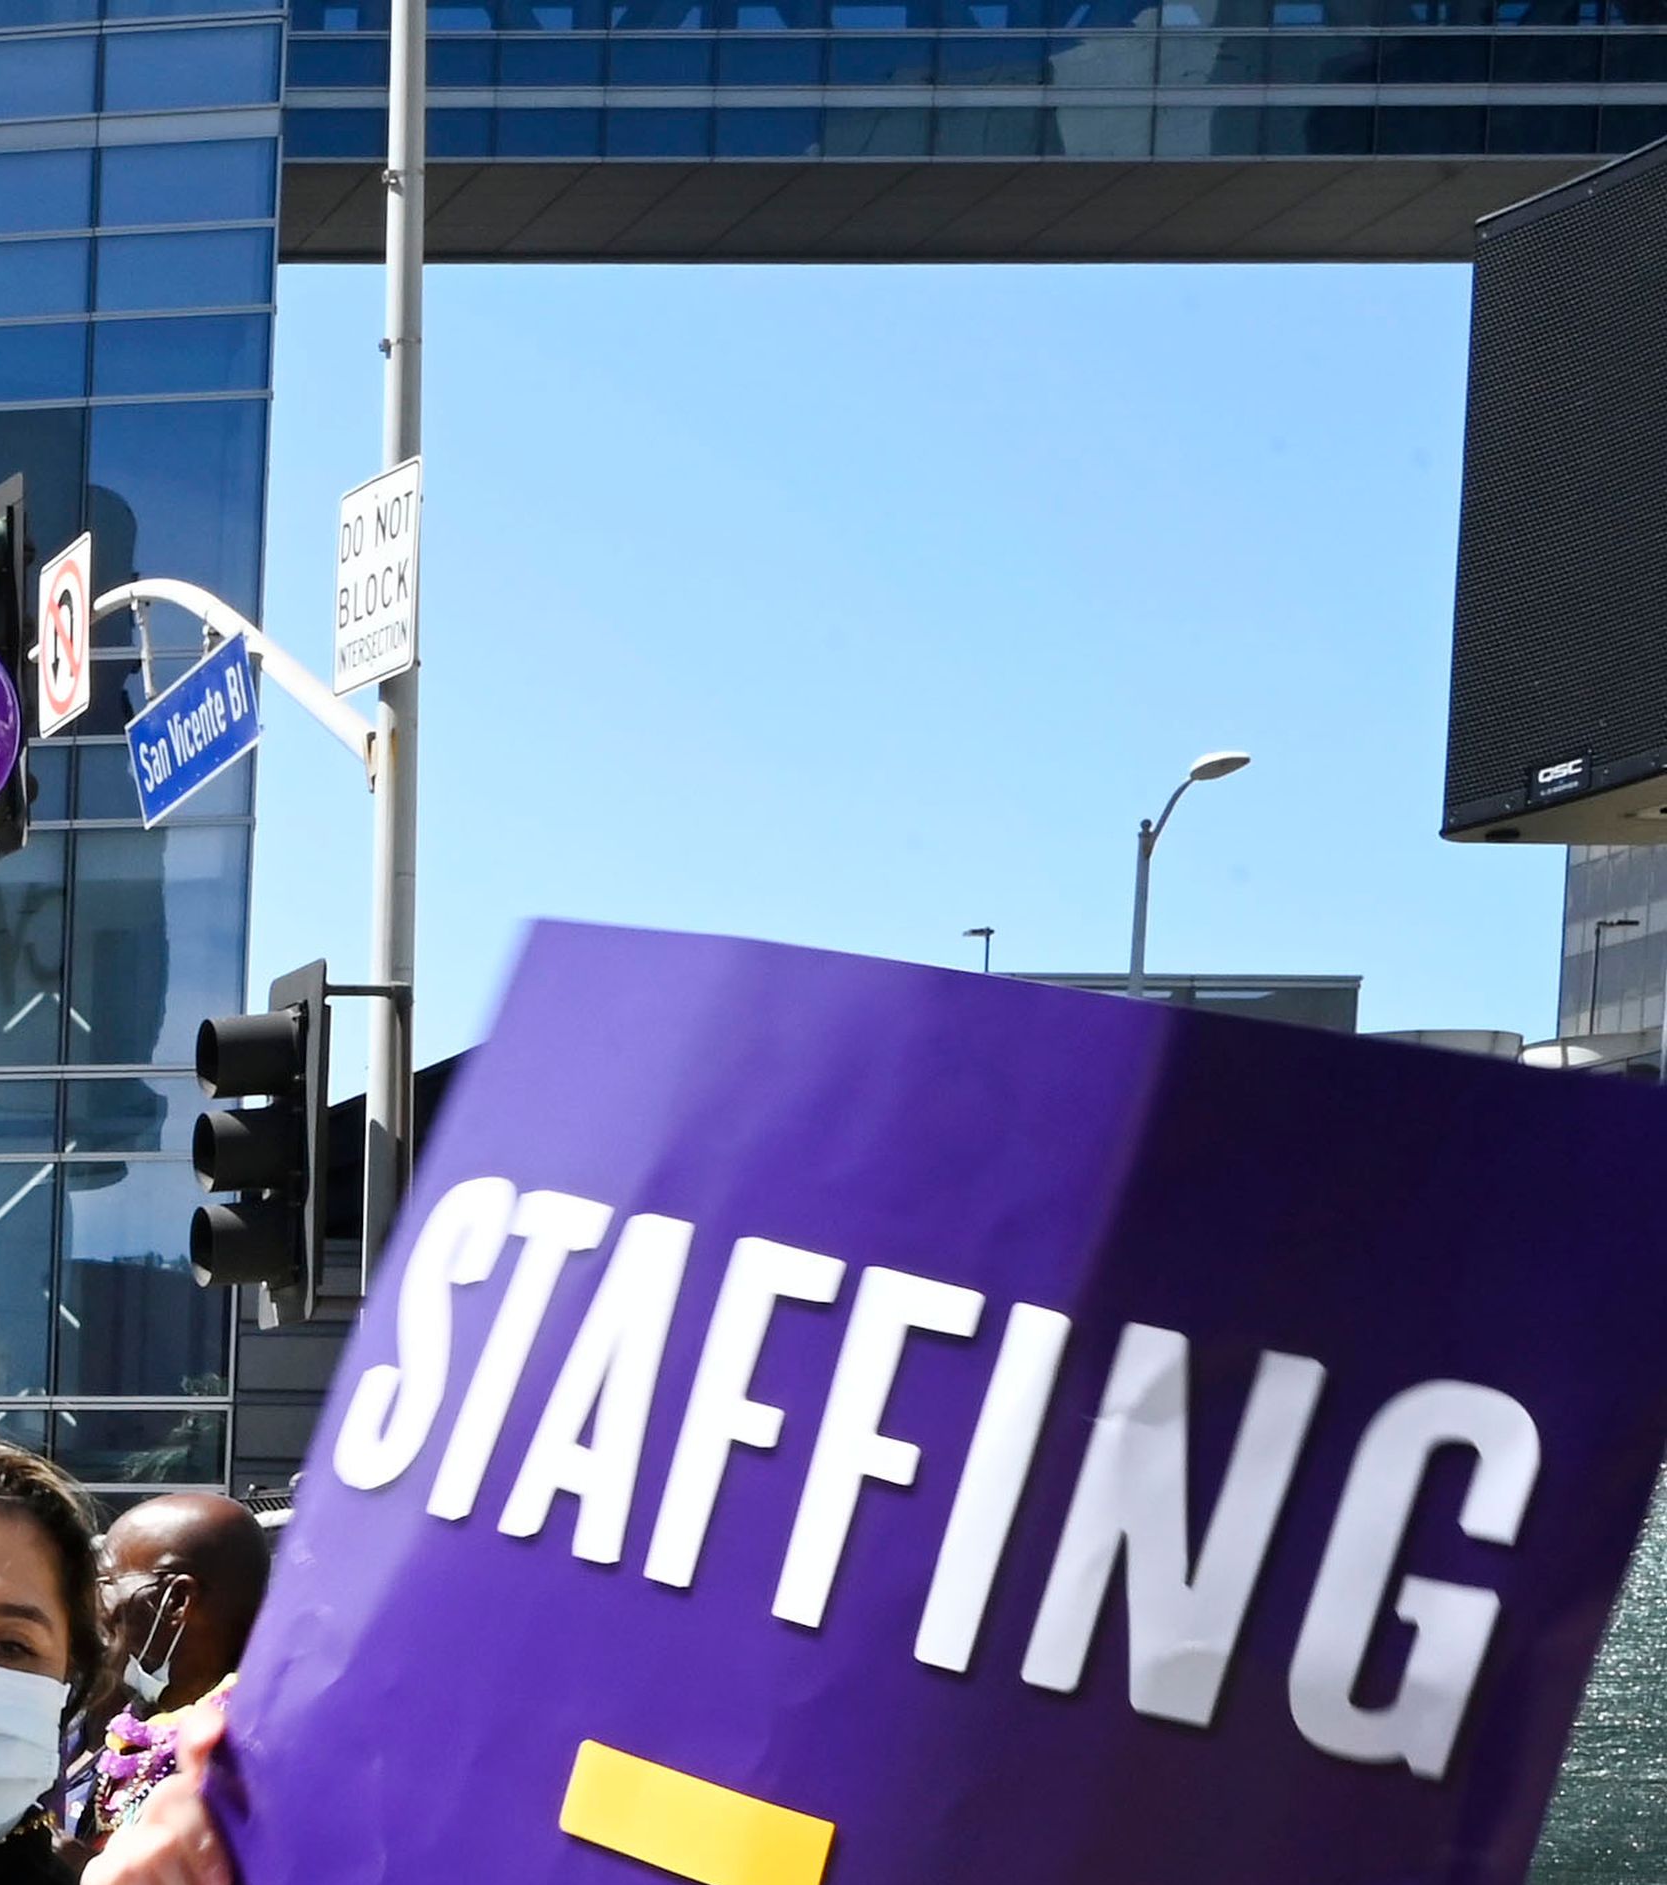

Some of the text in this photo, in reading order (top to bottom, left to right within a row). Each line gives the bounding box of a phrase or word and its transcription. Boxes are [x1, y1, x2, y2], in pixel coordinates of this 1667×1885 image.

[340, 490, 414, 564] DO NOT
[338, 558, 410, 629] BLOCK
[337, 617, 410, 674] INTERSECTION
[139, 738, 172, 793] San
[167, 687, 227, 767] Vicente
[1538, 758, 1583, 783] QSC
[333, 1176, 1541, 1781] STAFFING
